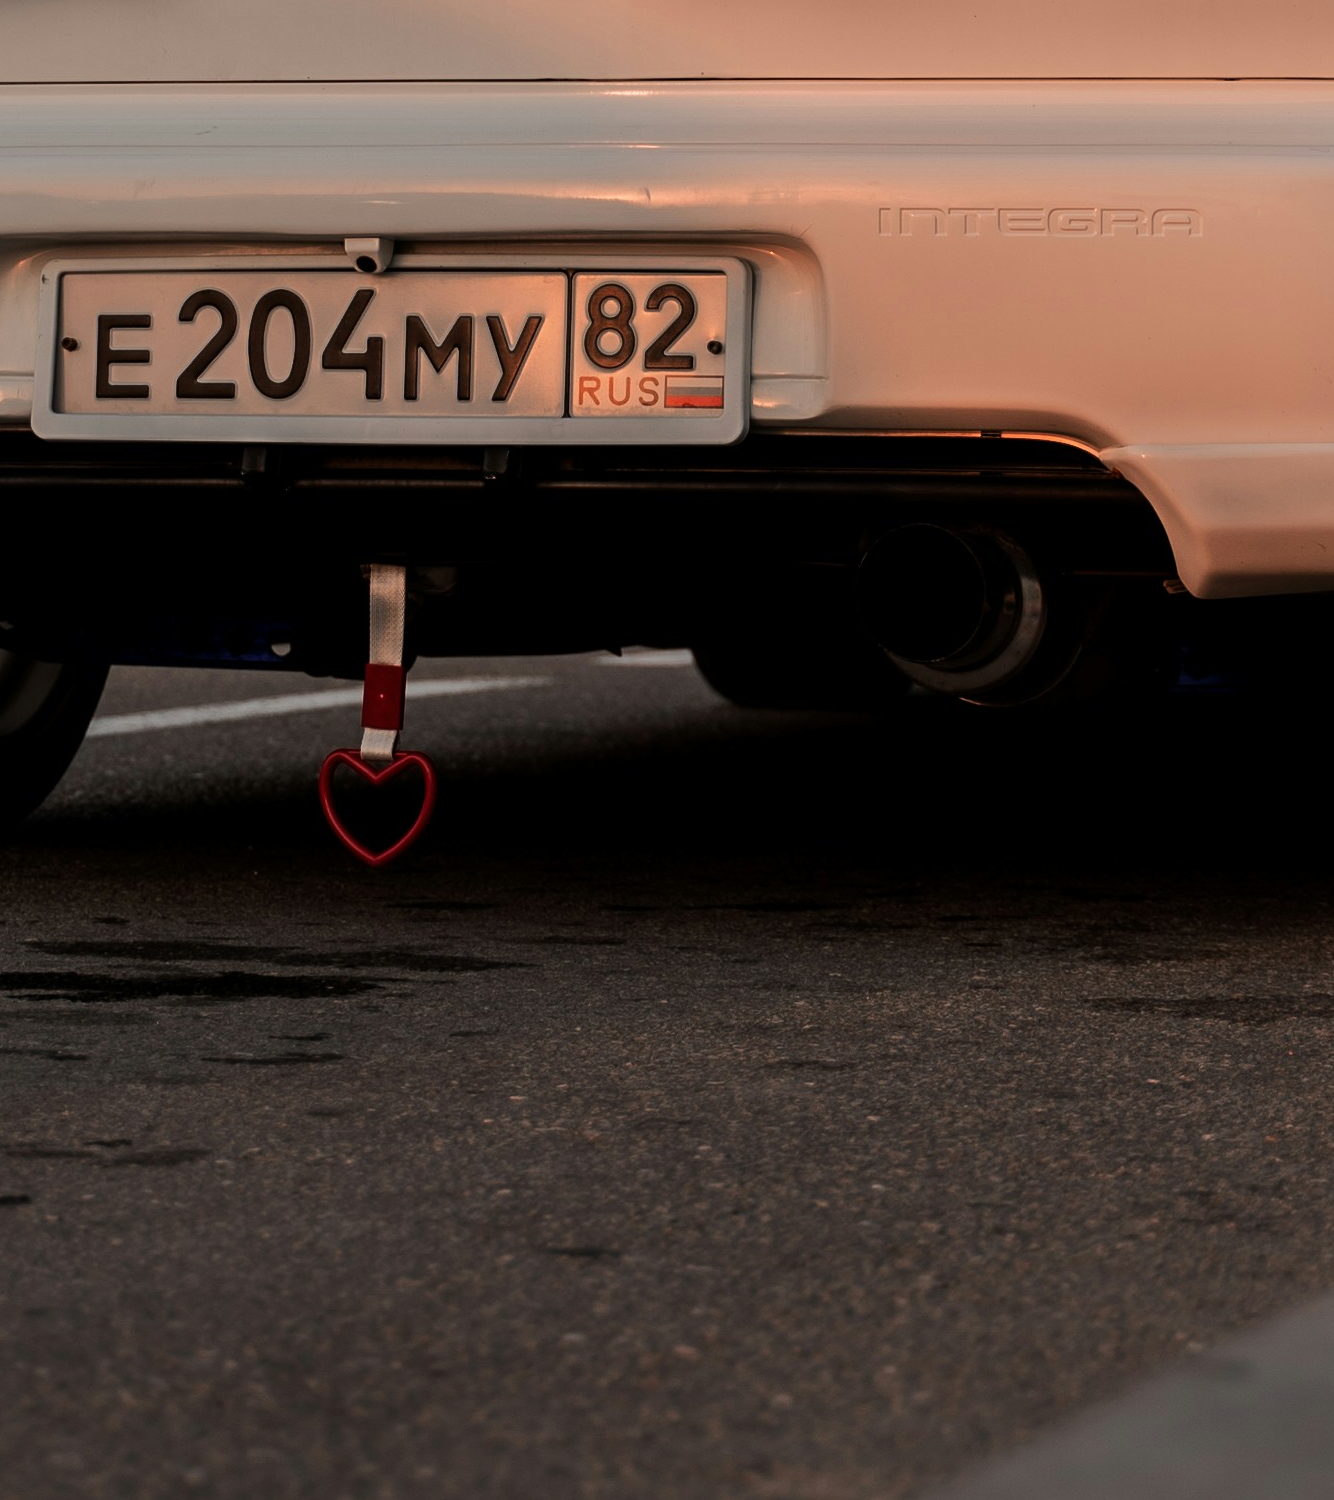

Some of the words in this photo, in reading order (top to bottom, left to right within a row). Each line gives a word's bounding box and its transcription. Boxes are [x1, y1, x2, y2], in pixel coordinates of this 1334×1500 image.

[878, 207, 1204, 238] INTEGRA
[584, 281, 698, 370] 82
[578, 376, 660, 406] RUS
